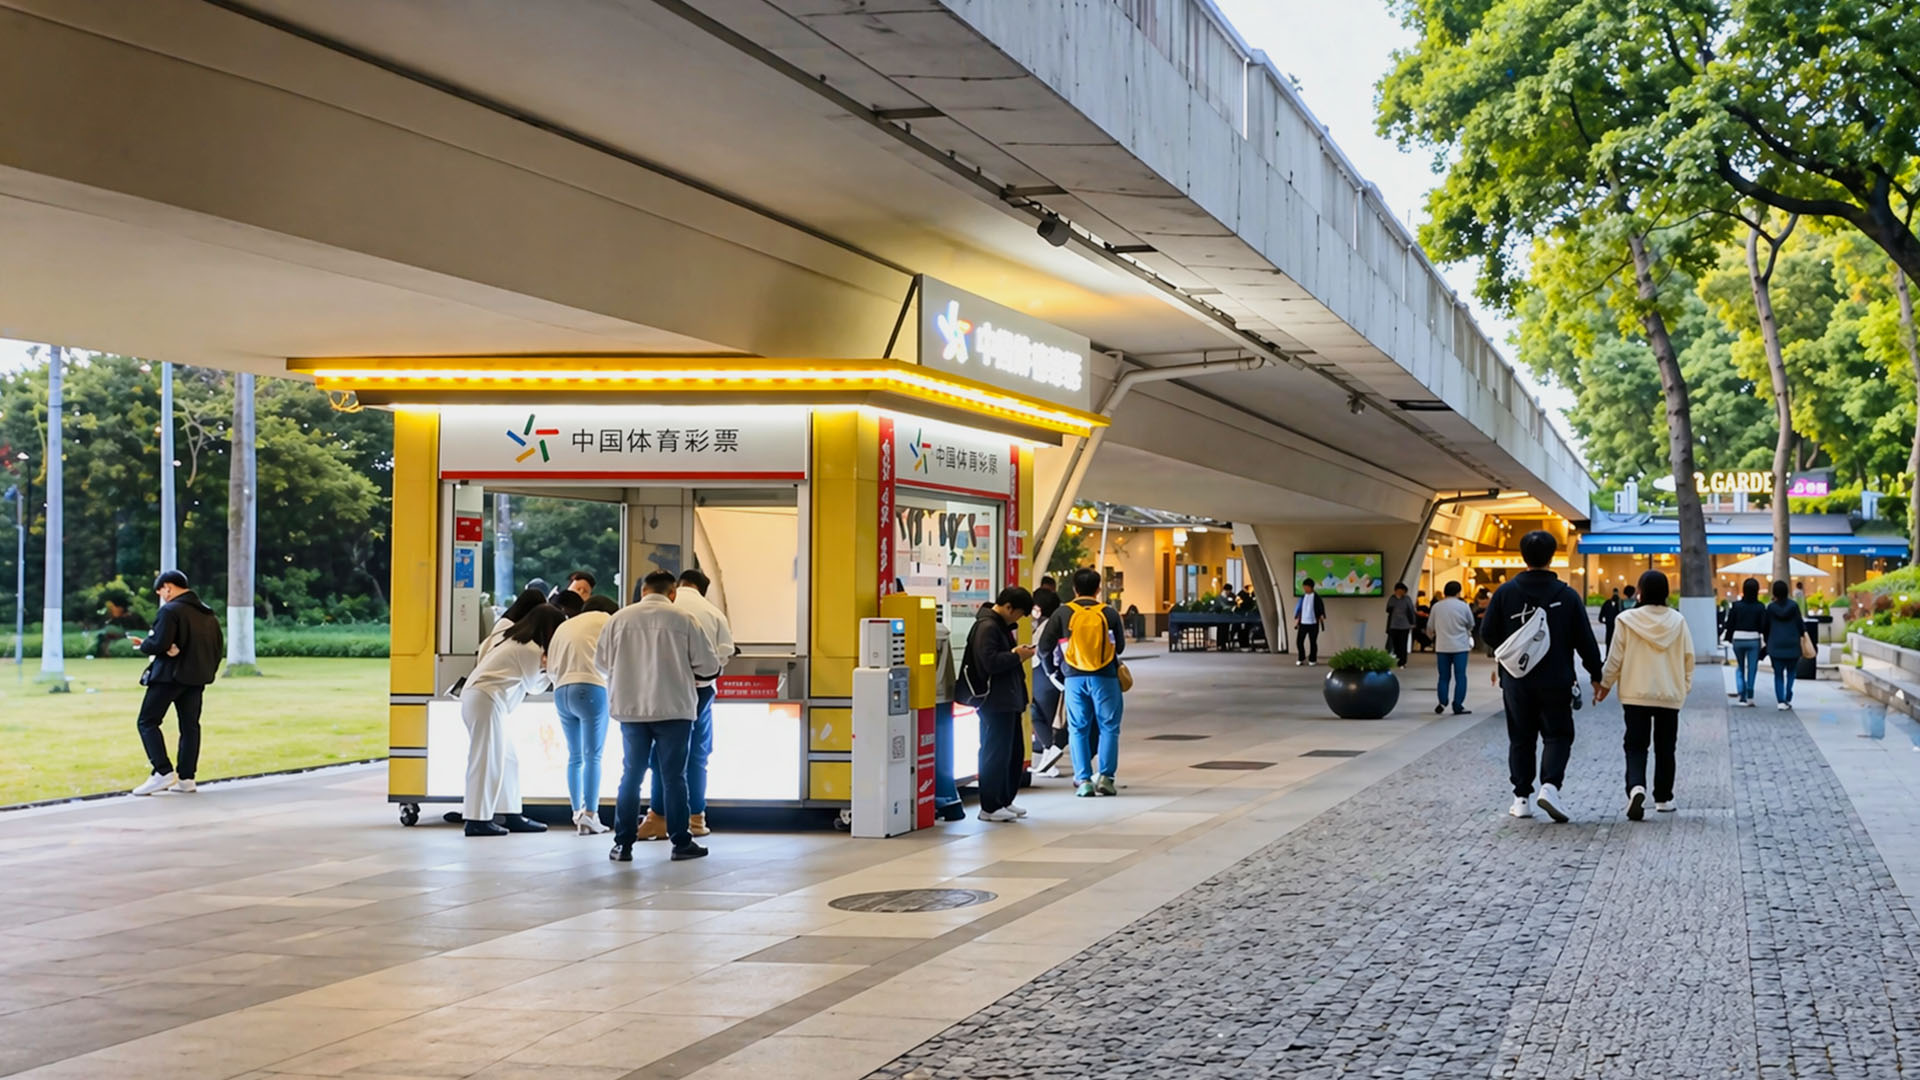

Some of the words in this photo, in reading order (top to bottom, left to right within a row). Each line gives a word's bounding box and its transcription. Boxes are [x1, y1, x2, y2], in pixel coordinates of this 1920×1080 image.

[572, 428, 740, 453] 中国体育彩票
